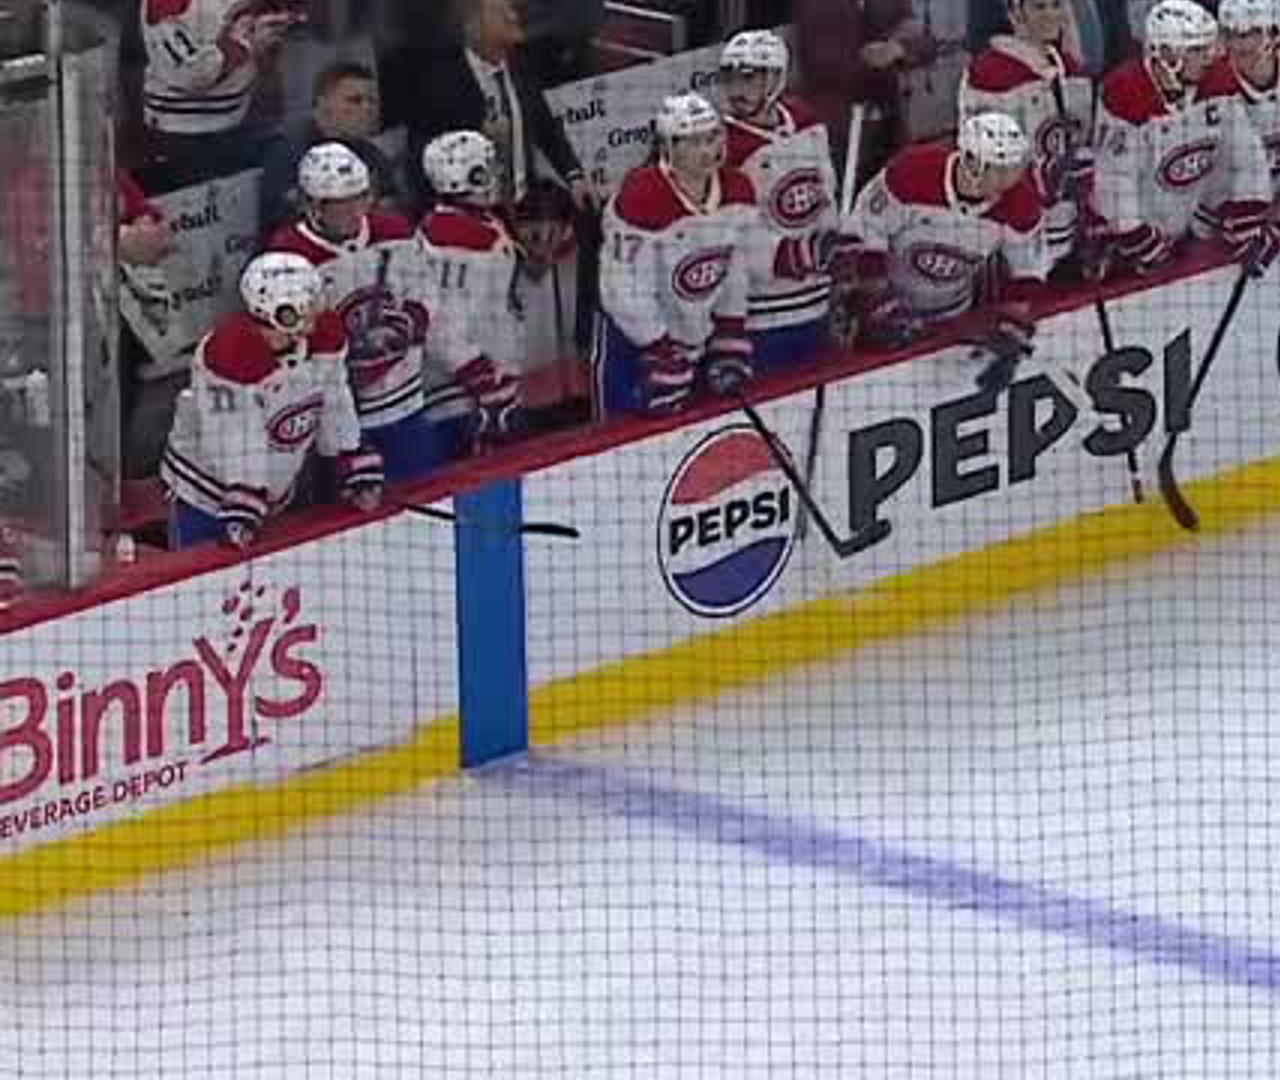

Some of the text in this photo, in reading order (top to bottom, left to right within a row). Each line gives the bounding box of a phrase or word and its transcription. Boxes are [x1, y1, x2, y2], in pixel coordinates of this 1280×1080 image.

[848, 327, 1191, 533] PEPSI
[669, 486, 790, 556] PEPSI
[113, 760, 189, 803] DEPOT
